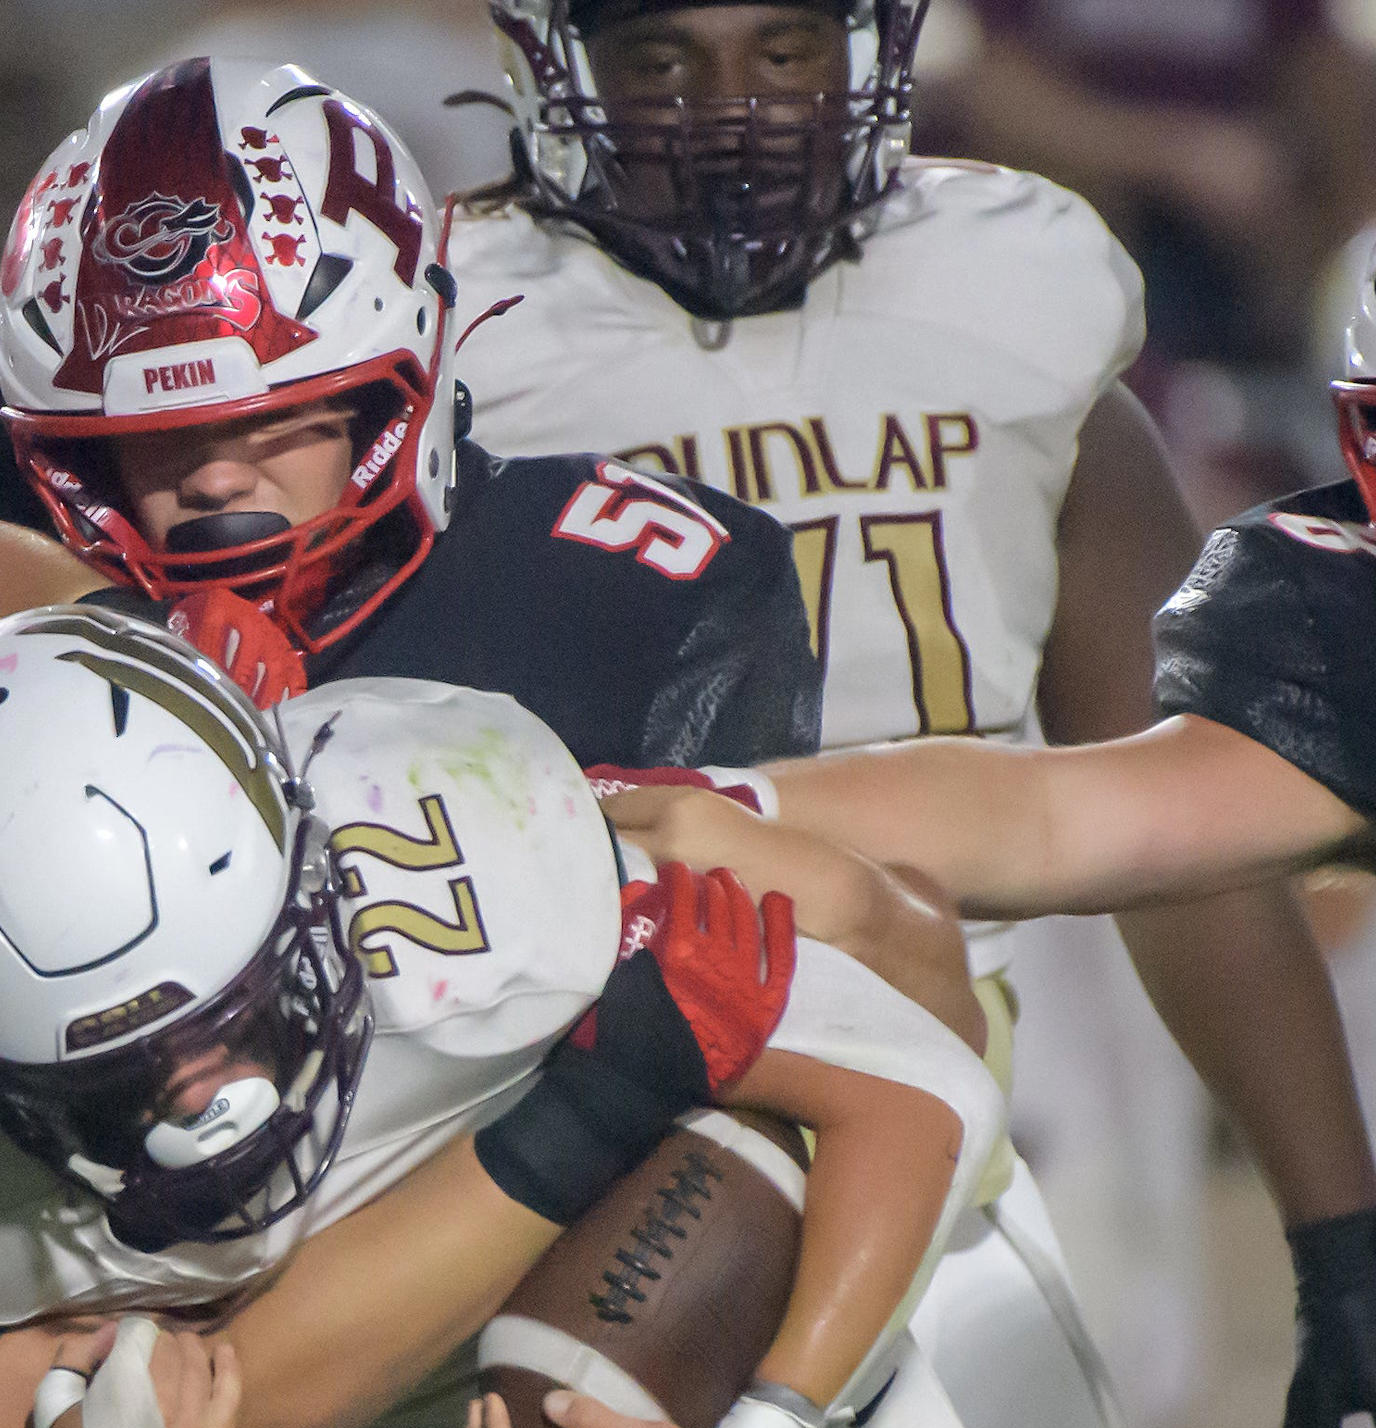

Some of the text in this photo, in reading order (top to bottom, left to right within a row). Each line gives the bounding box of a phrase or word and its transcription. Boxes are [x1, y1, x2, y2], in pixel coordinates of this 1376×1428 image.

[320, 101, 424, 288] P
[143, 358, 216, 394] PEKIN
[350, 421, 409, 489] Ridde
[329, 793, 491, 979] 22
